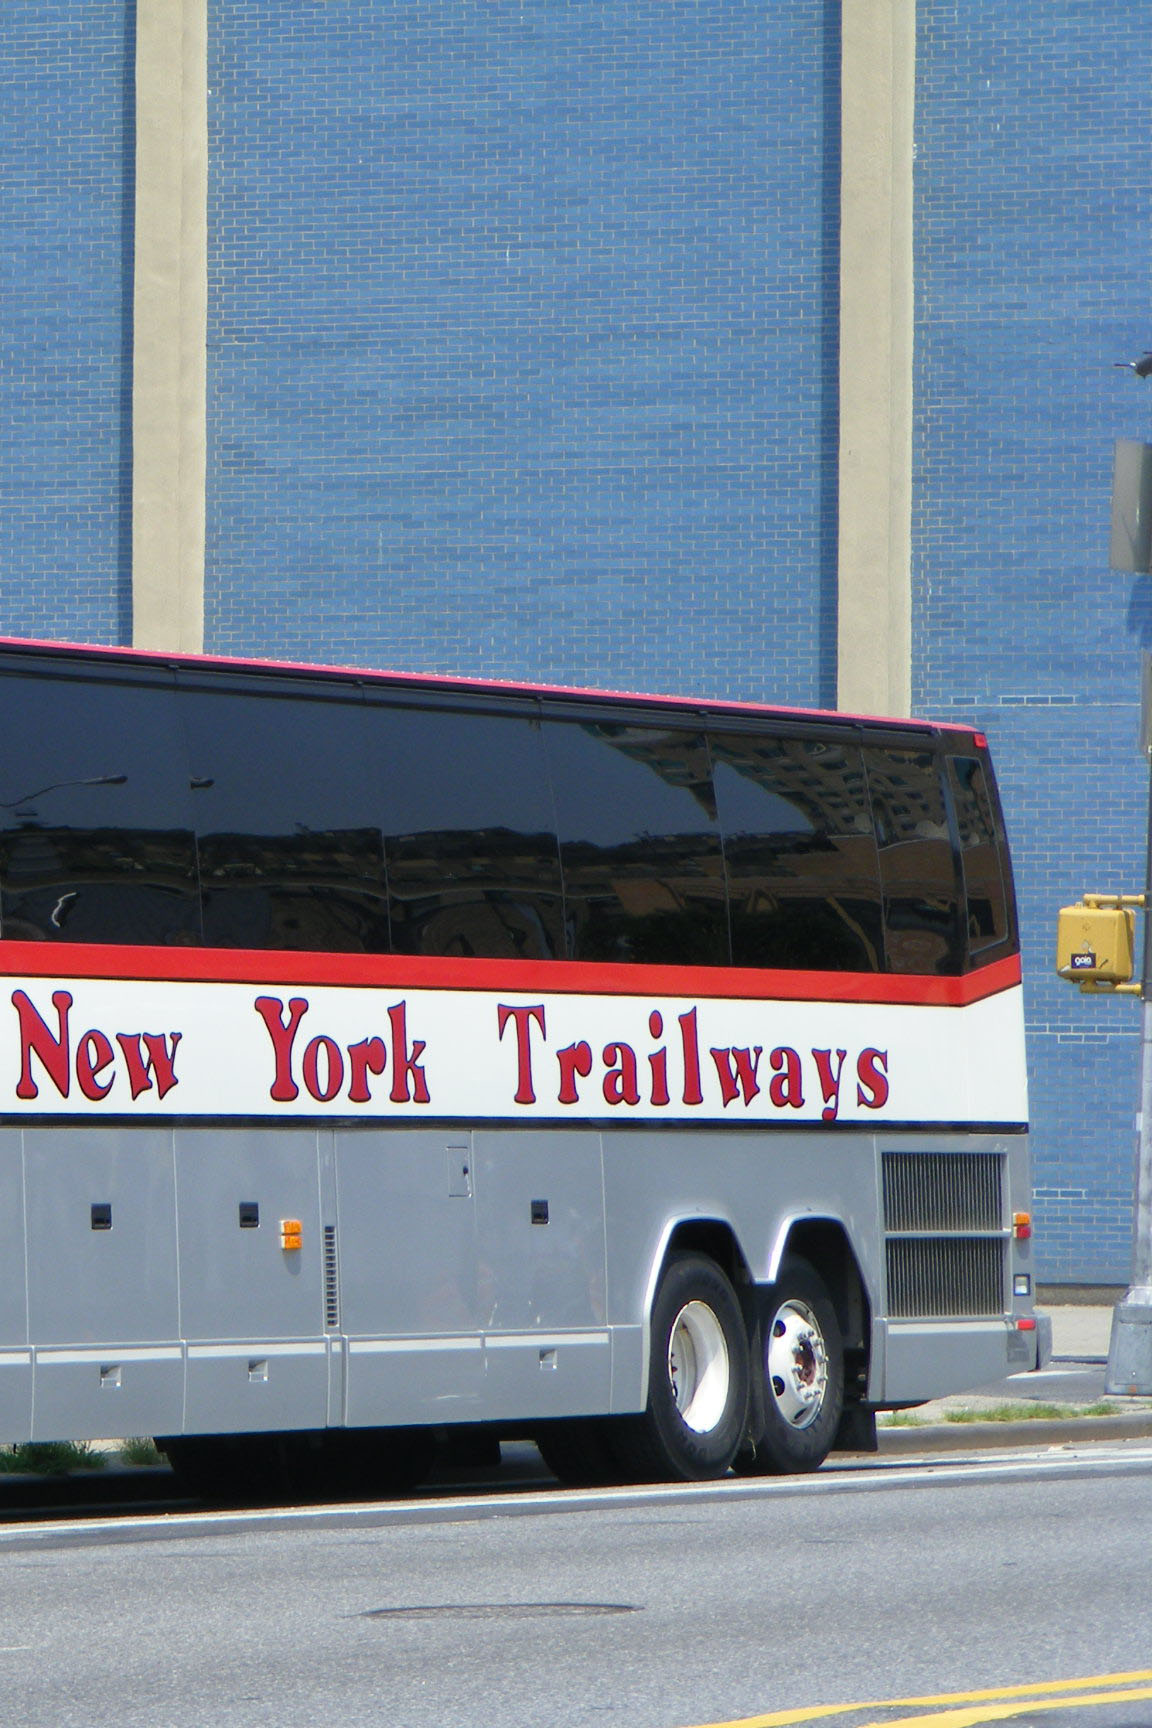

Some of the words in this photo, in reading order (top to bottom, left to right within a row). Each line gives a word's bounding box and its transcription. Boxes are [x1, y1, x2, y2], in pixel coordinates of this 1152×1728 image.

[11, 989, 183, 1101] New
[254, 995, 431, 1104] York
[497, 1003, 890, 1122] Trailways
